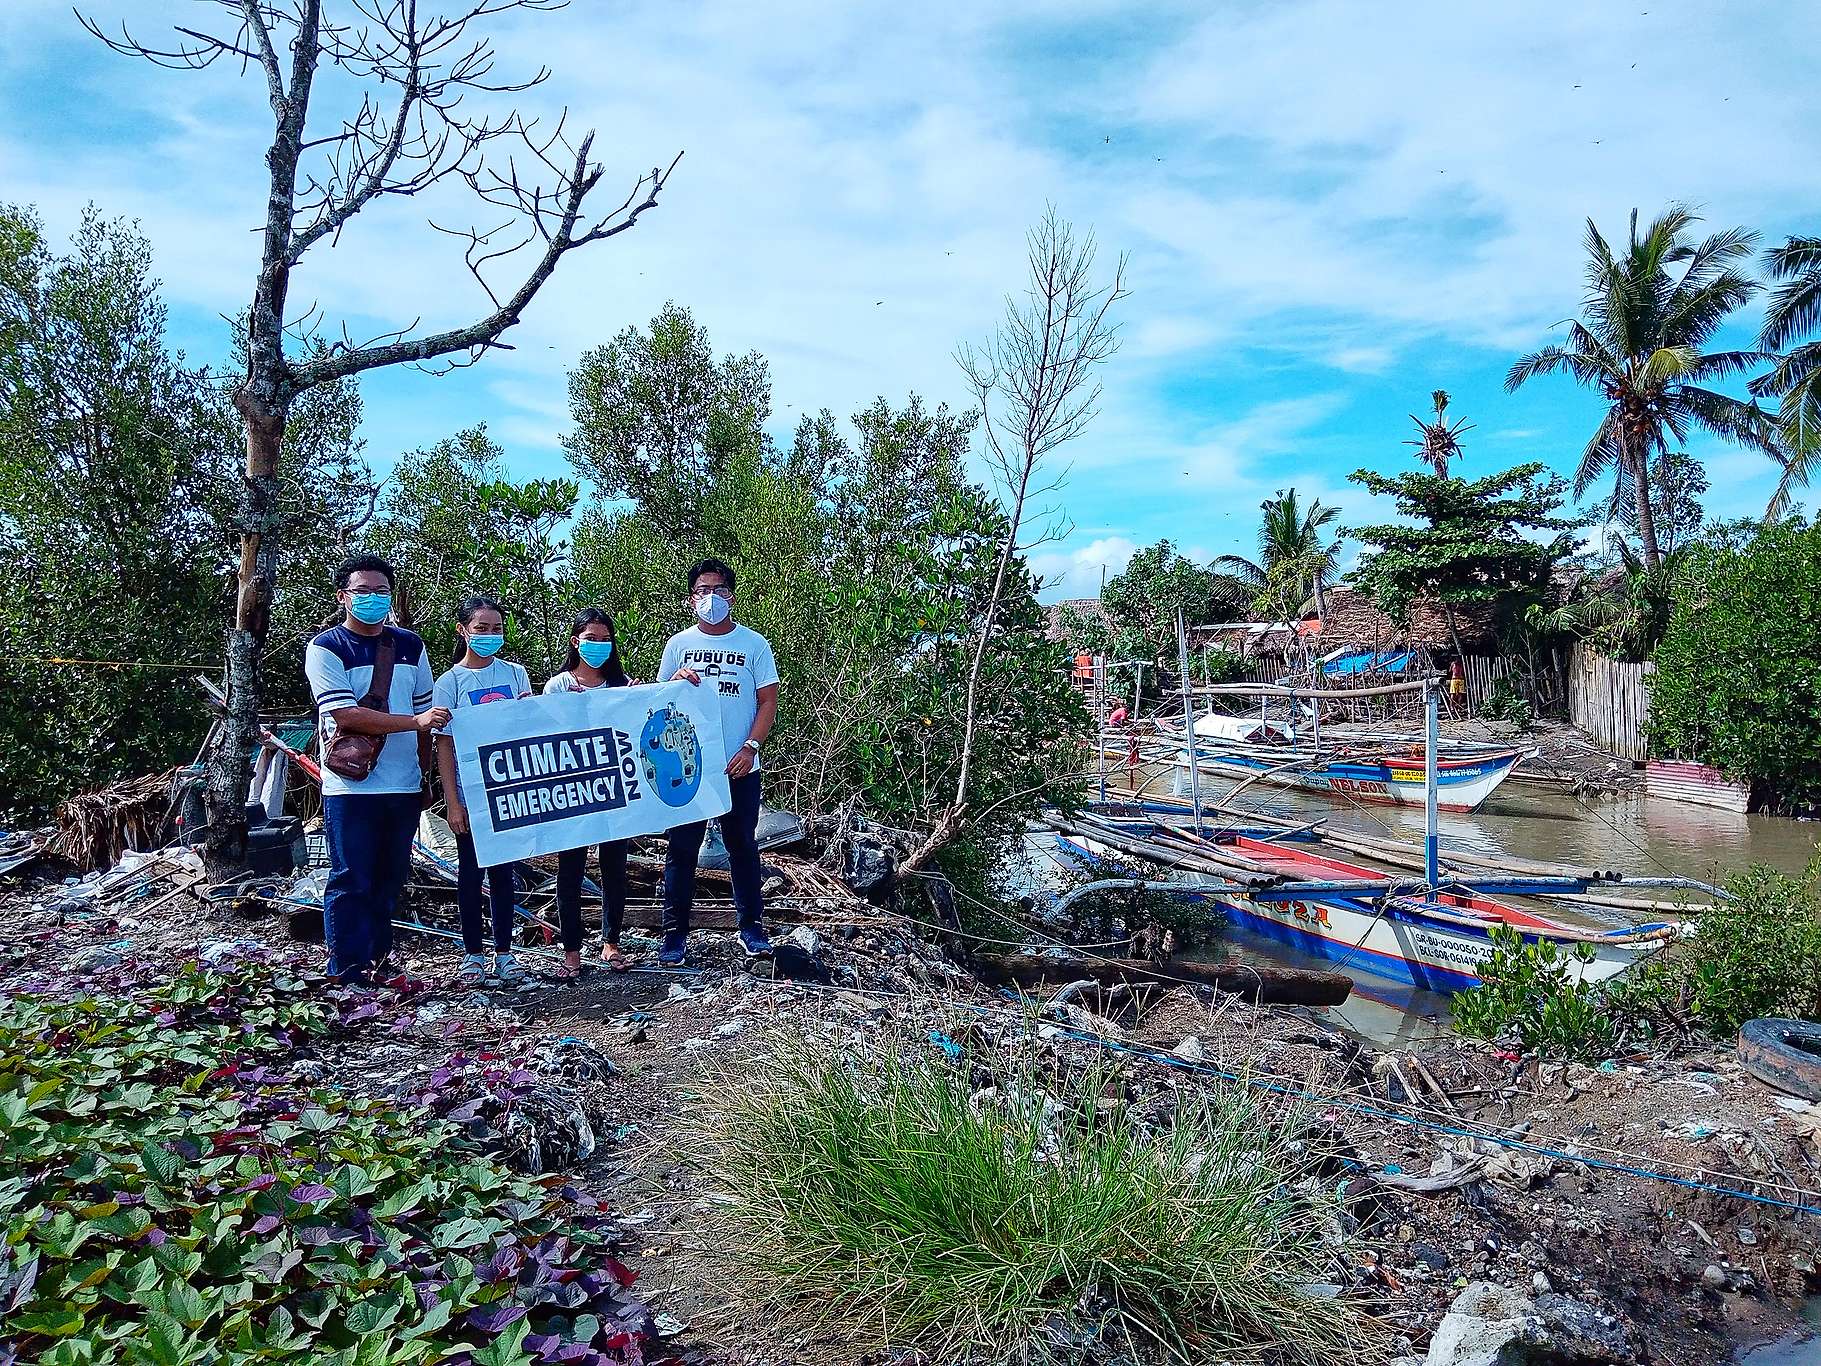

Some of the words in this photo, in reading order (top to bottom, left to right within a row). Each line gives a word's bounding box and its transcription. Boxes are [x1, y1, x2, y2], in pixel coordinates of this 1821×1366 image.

[684, 652, 723, 663] FUBU
[487, 735, 611, 782] CLIMATE
[615, 730, 641, 801] NOW
[496, 775, 617, 821] EMERGENCY
[1328, 777, 1388, 794] NELSON
